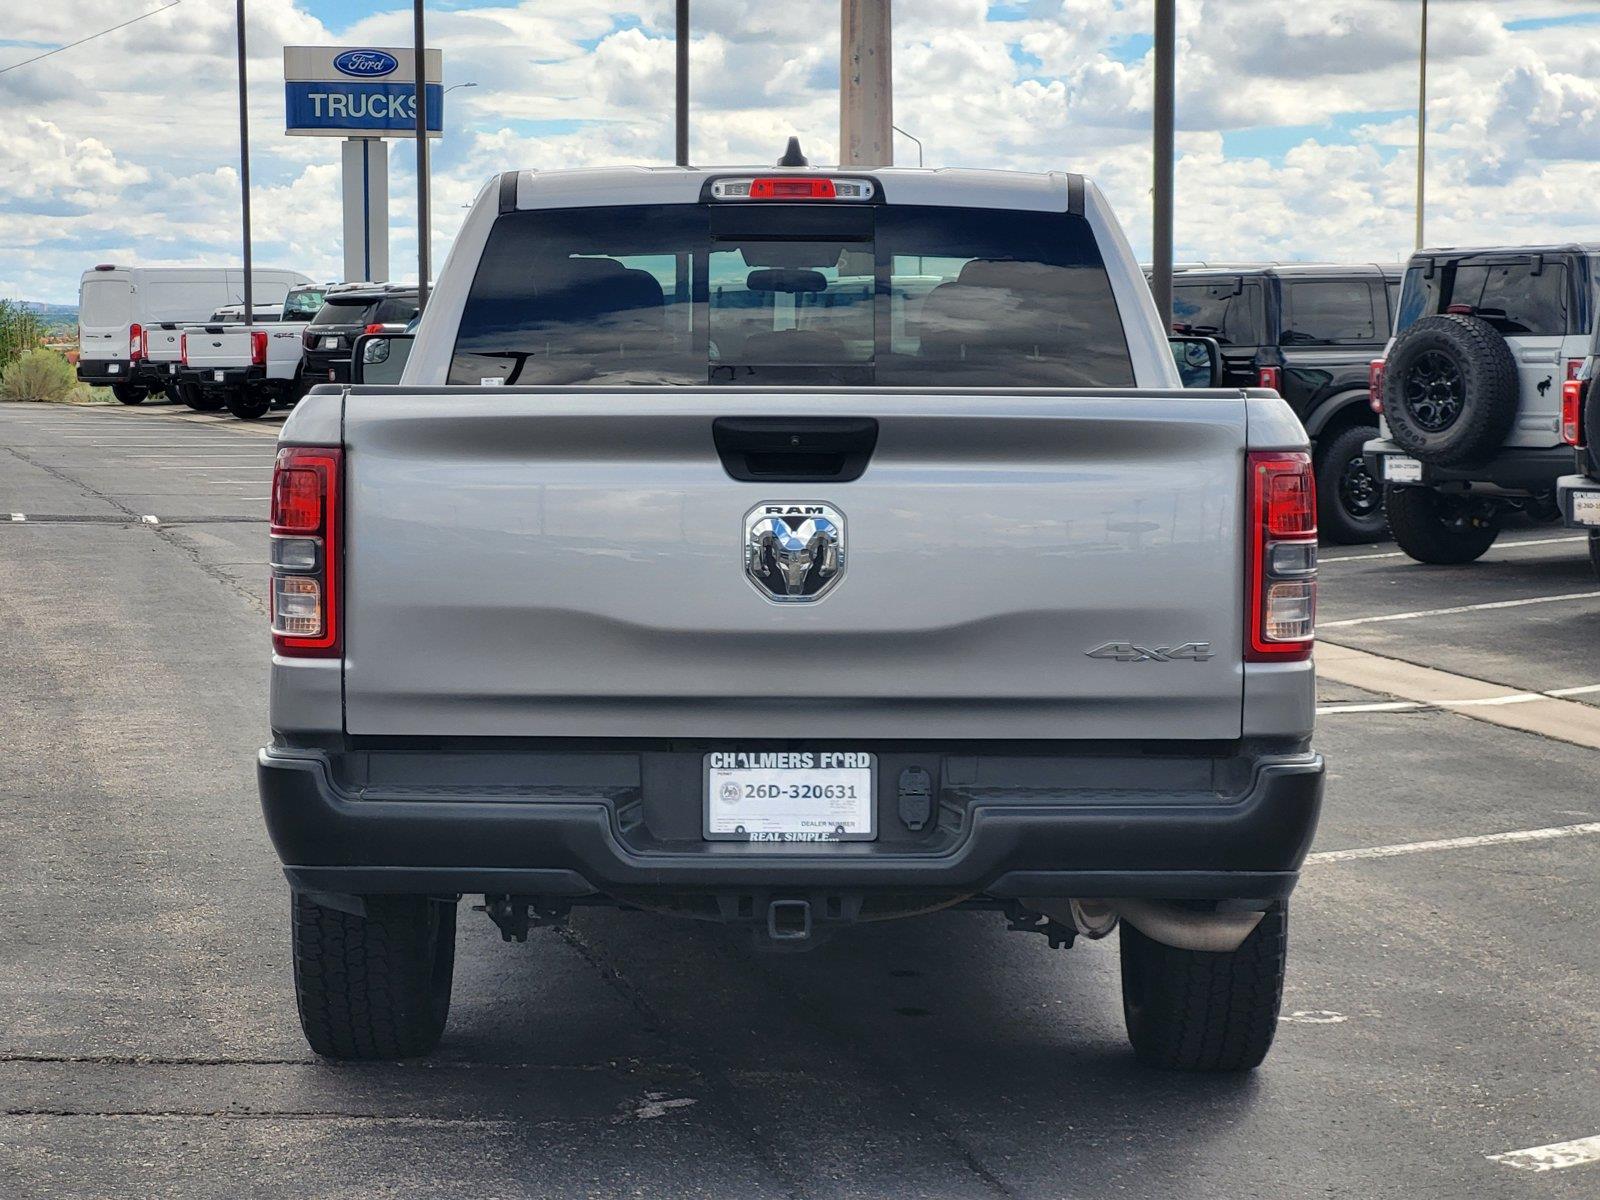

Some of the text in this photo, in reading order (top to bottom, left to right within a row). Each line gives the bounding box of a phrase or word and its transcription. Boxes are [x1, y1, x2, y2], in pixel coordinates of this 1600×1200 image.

[348, 53, 384, 70] Ford
[710, 752, 870, 769] CHALMERS FORD
[745, 784, 857, 799] 26D-320631
[749, 832, 781, 842] REAL
